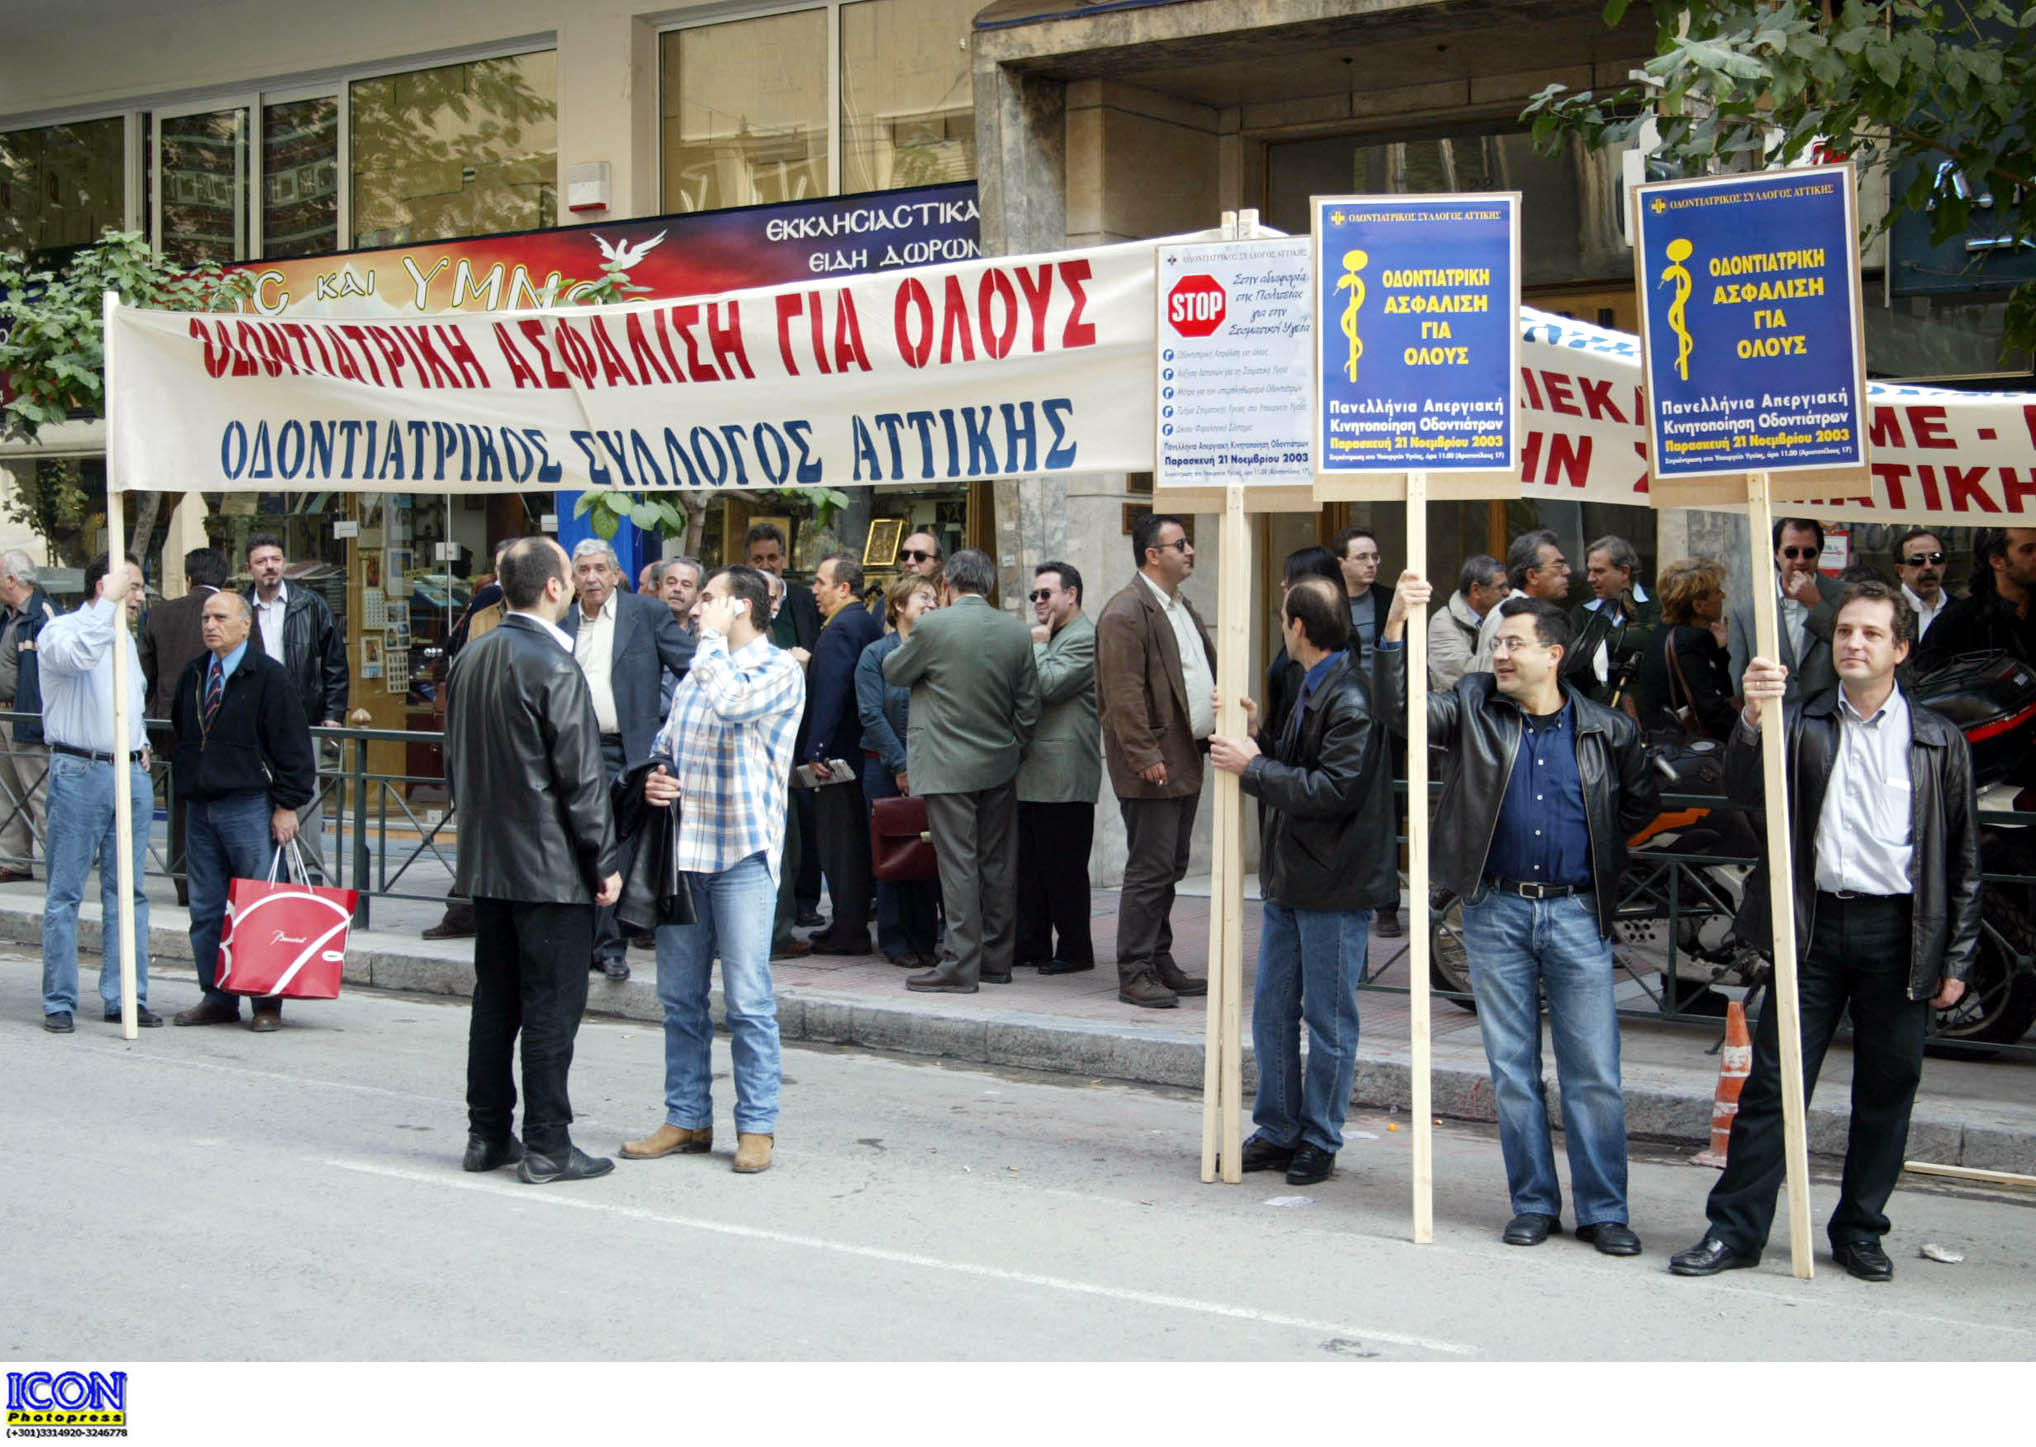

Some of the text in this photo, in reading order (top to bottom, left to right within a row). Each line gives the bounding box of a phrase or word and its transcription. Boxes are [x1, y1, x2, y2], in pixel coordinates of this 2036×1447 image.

[1670, 184, 1834, 210] ΟΔΟΝΤΙΑΤΡΙΚΟΣ ΣΥΛΛΟΓΟΣ ΑΤΤΙΚΗΣ
[1349, 211, 1501, 223] ΟΔΟΝΤΙΑΤΡΙΚΟΣ ΣΥΛΛΟΓΟΣ ΑΤΤΙΚΗΣ
[1709, 248, 1825, 277] ΟΔΟΝΤΙΑΤΡΙΚΗ
[1382, 268, 1490, 288] ΟΔΟΝΤΙΑΤΡΙΚΗ
[1713, 277, 1824, 305] ΑΣΦΑΛΙΣΗ
[1172, 291, 1223, 322] STOP
[1384, 295, 1488, 314] ΑΣΦΑΛΙΣΗ
[190, 259, 1096, 389] ΟΔΟΝΤΙΑΤΡΙΚΗ ΑΣΦΑΛΙΣΗ ΓΙΑ ΟΛΟΥΣ
[1421, 321, 1452, 339] ΓΙΑ
[1754, 309, 1787, 329] ΓΙΑ
[1404, 347, 1469, 366] ΟΛΟΥΣ
[1737, 335, 1807, 359] ΟΛΟΥΣ
[1330, 397, 1504, 416] Πανελλήνια Απεργιακή
[1662, 396, 1754, 415] Πανελλήνια
[1762, 387, 1848, 409] Απεργιακή
[1330, 417, 1503, 435] Κινητοποίηση Οδοντιάτρων
[1663, 411, 1848, 436] Κινητοποίηση Οδοντιάτρων
[221, 398, 1077, 487] ΟΔΟΝΤΙΑΤΡΙΚΟΣ ΣΥΛΛΟΓΟΣ ΑΤΤΙΚΗΣ
[1330, 436, 1503, 451] Παρασκευή 21 Νοεμβρίου 2003
[1665, 429, 1850, 454] Παρασκευή 21 Νοεμβρίου 2003
[1165, 452, 1309, 468] Παρασκευή 21 Νοεμβρίου 2003
